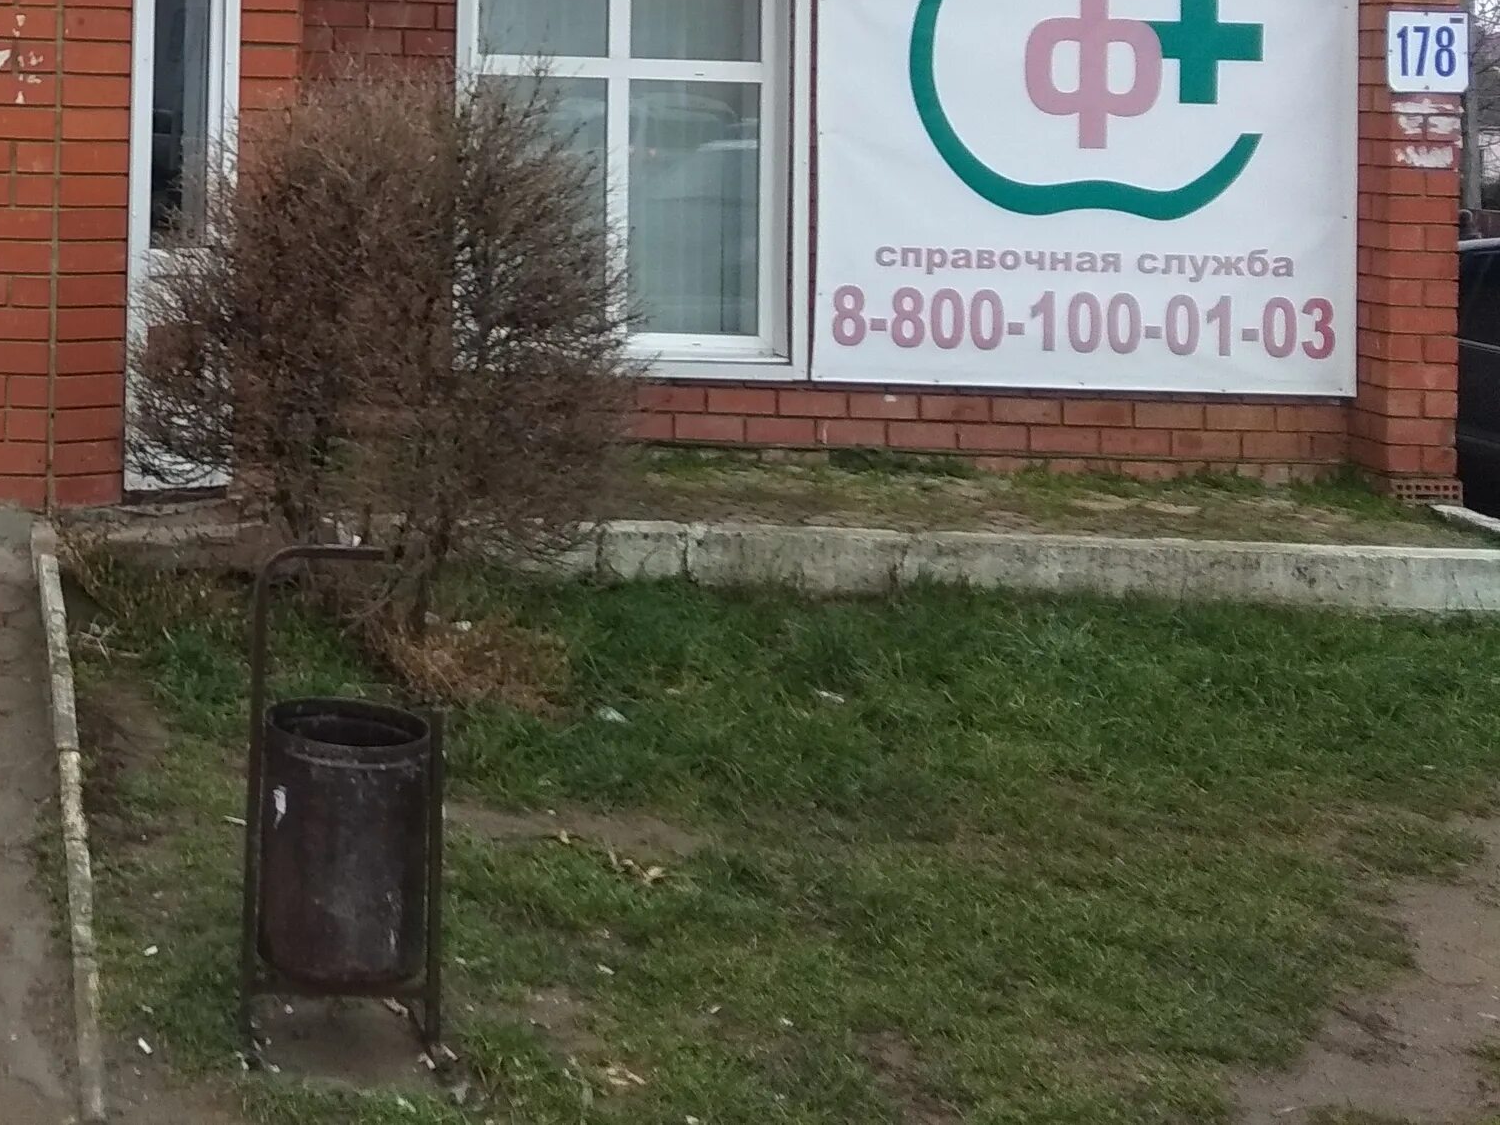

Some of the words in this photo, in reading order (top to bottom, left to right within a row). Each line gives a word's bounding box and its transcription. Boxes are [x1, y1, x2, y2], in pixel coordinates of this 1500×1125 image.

[1396, 25, 1457, 77] 178
[874, 243, 1122, 275] справочная
[1136, 247, 1295, 282] служба
[831, 284, 1337, 359] 8-800-100-01-03
